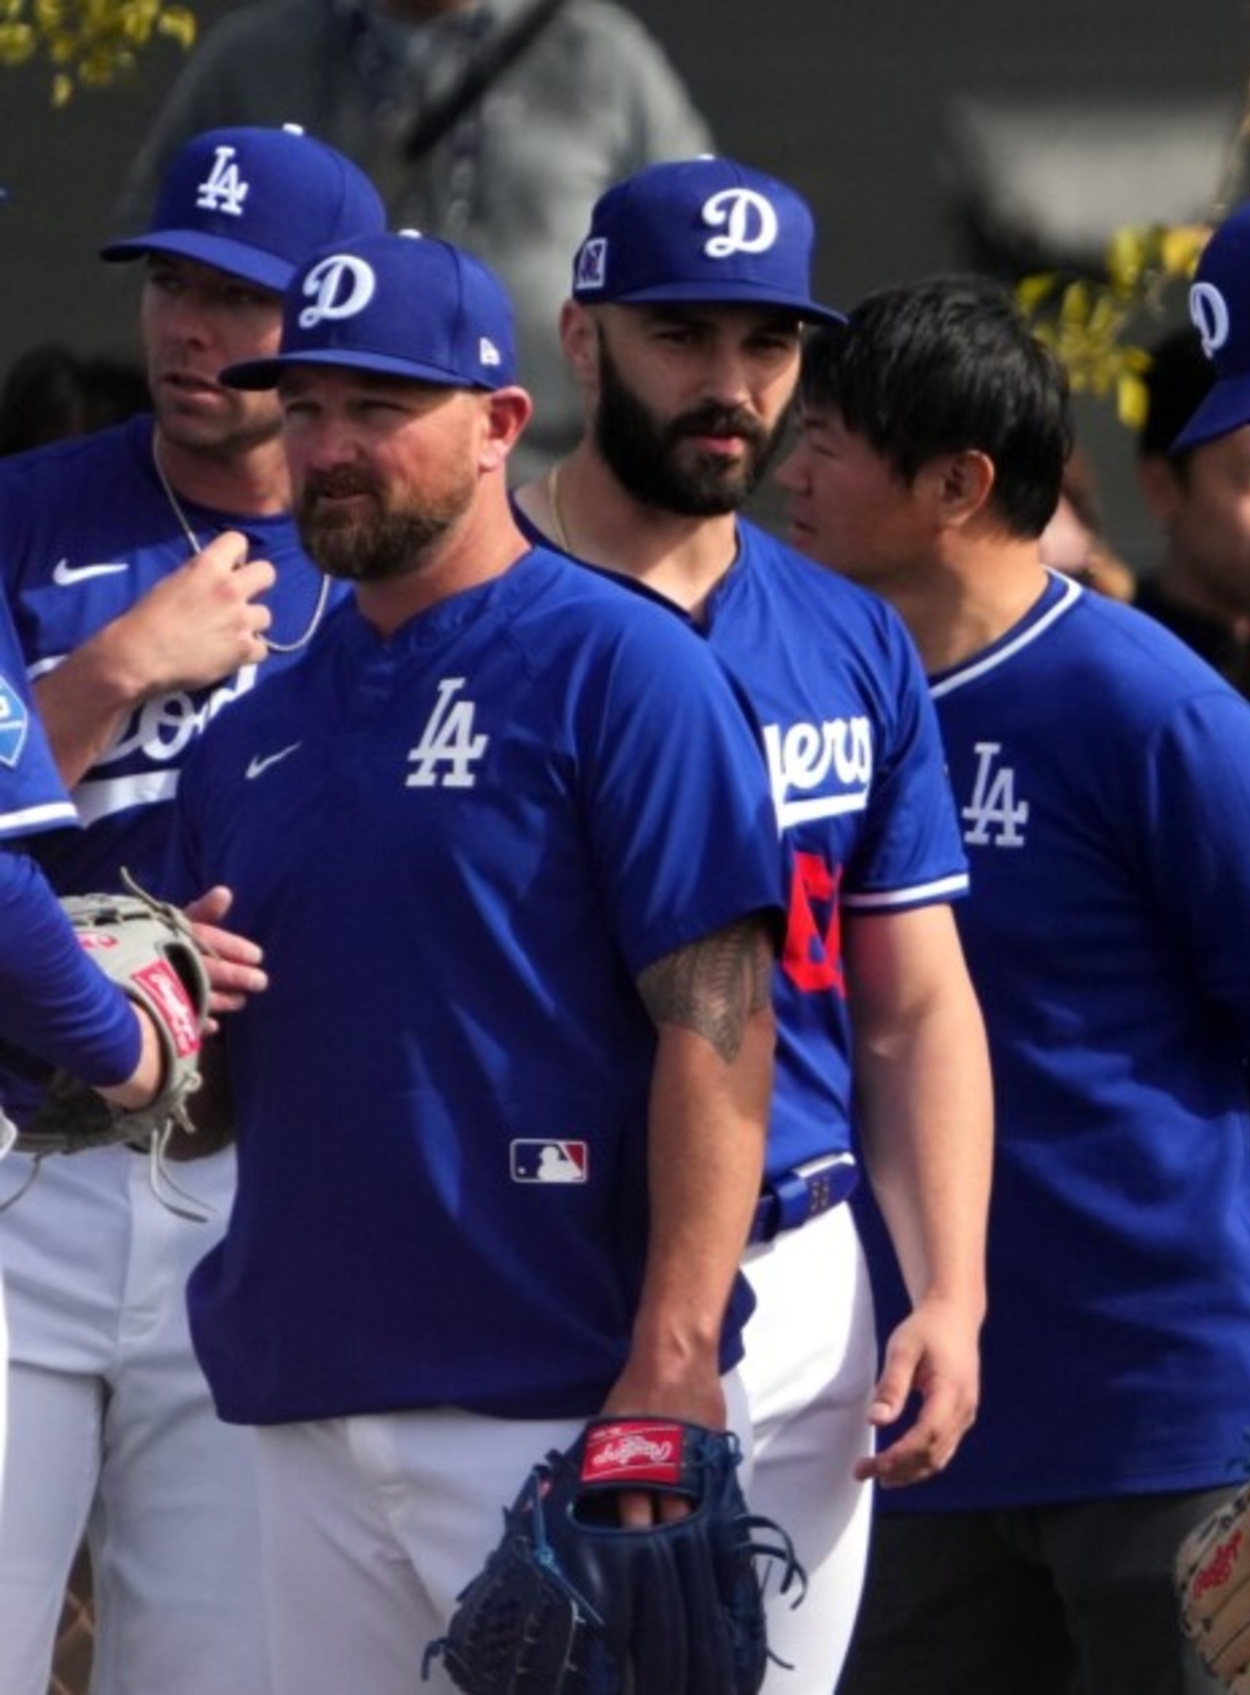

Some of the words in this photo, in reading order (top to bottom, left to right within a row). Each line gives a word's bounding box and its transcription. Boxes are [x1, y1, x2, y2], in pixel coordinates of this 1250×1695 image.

[197, 147, 248, 215] LA
[702, 188, 778, 258] D
[299, 255, 374, 327] D
[405, 677, 490, 787] LA
[962, 742, 1028, 846] LA
